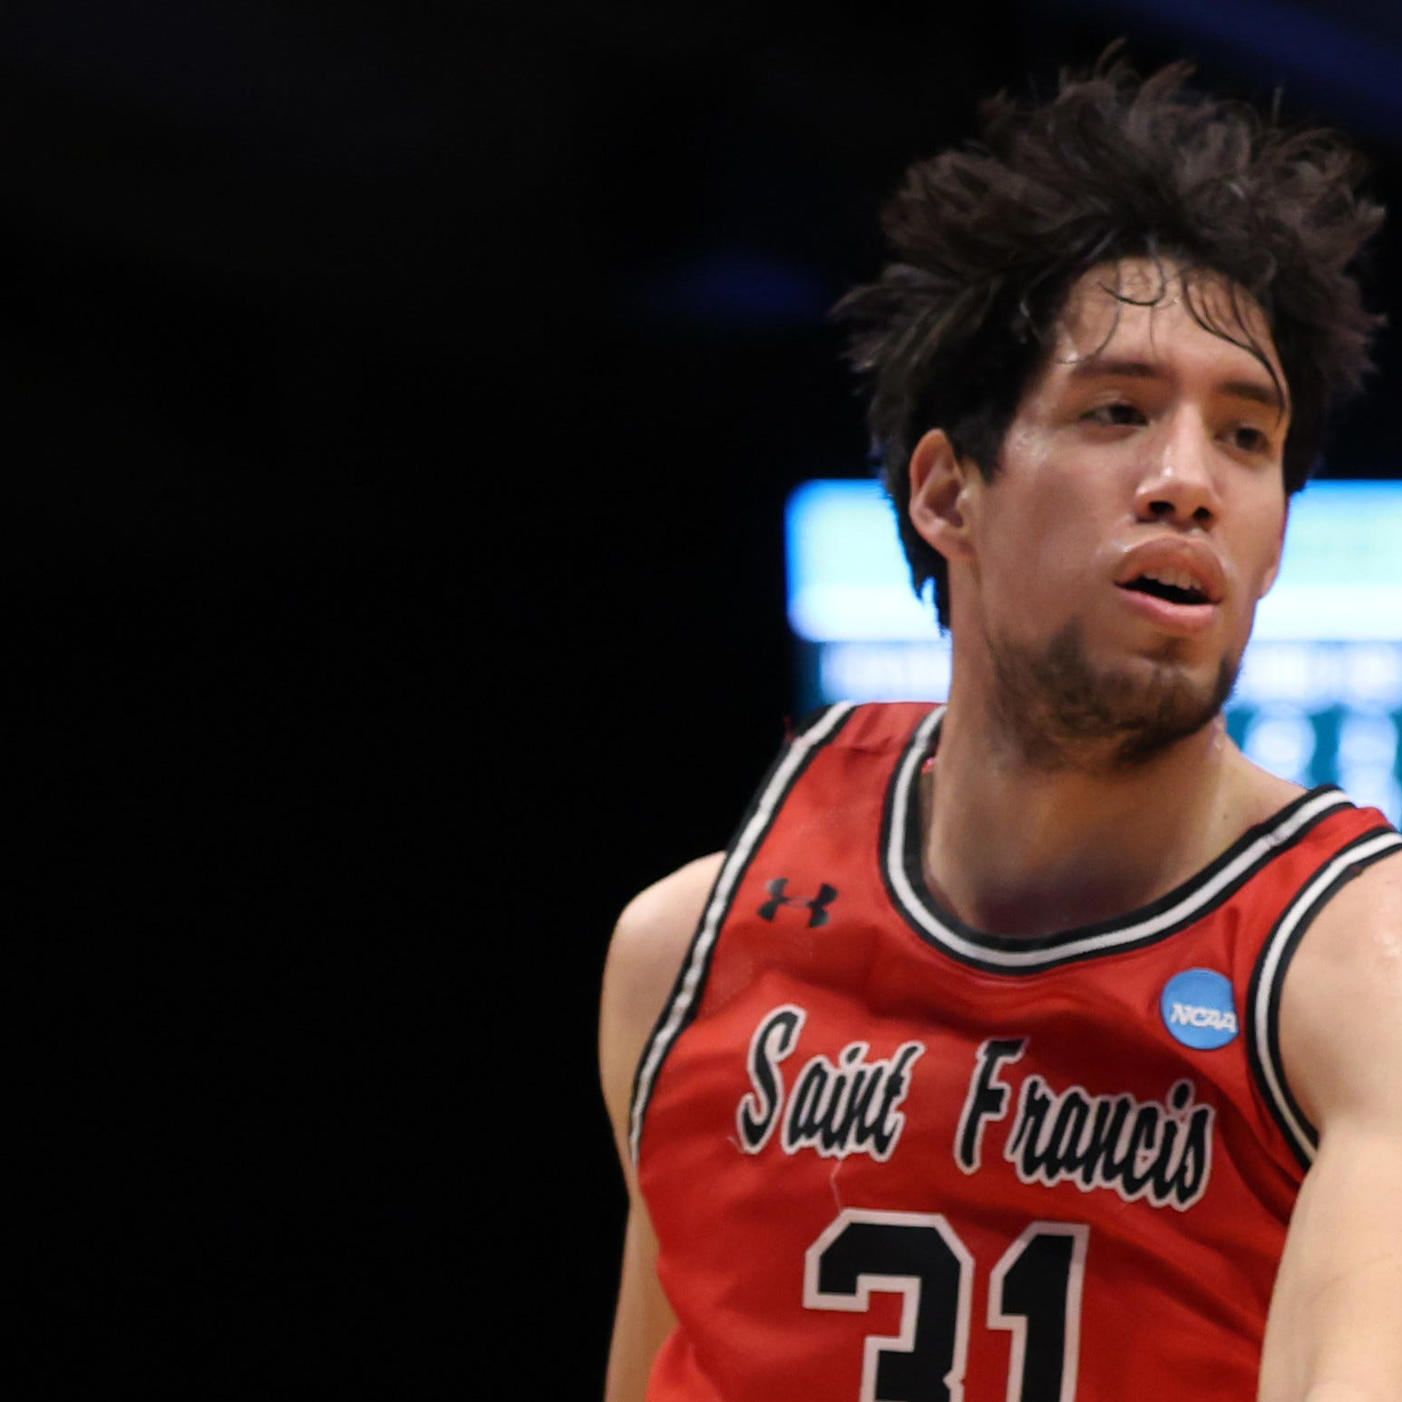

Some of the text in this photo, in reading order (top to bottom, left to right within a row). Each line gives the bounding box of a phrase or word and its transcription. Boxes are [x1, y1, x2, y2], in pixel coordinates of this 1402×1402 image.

[1170, 1002, 1238, 1033] NCAA
[737, 1004, 1213, 1212] Saint Francis
